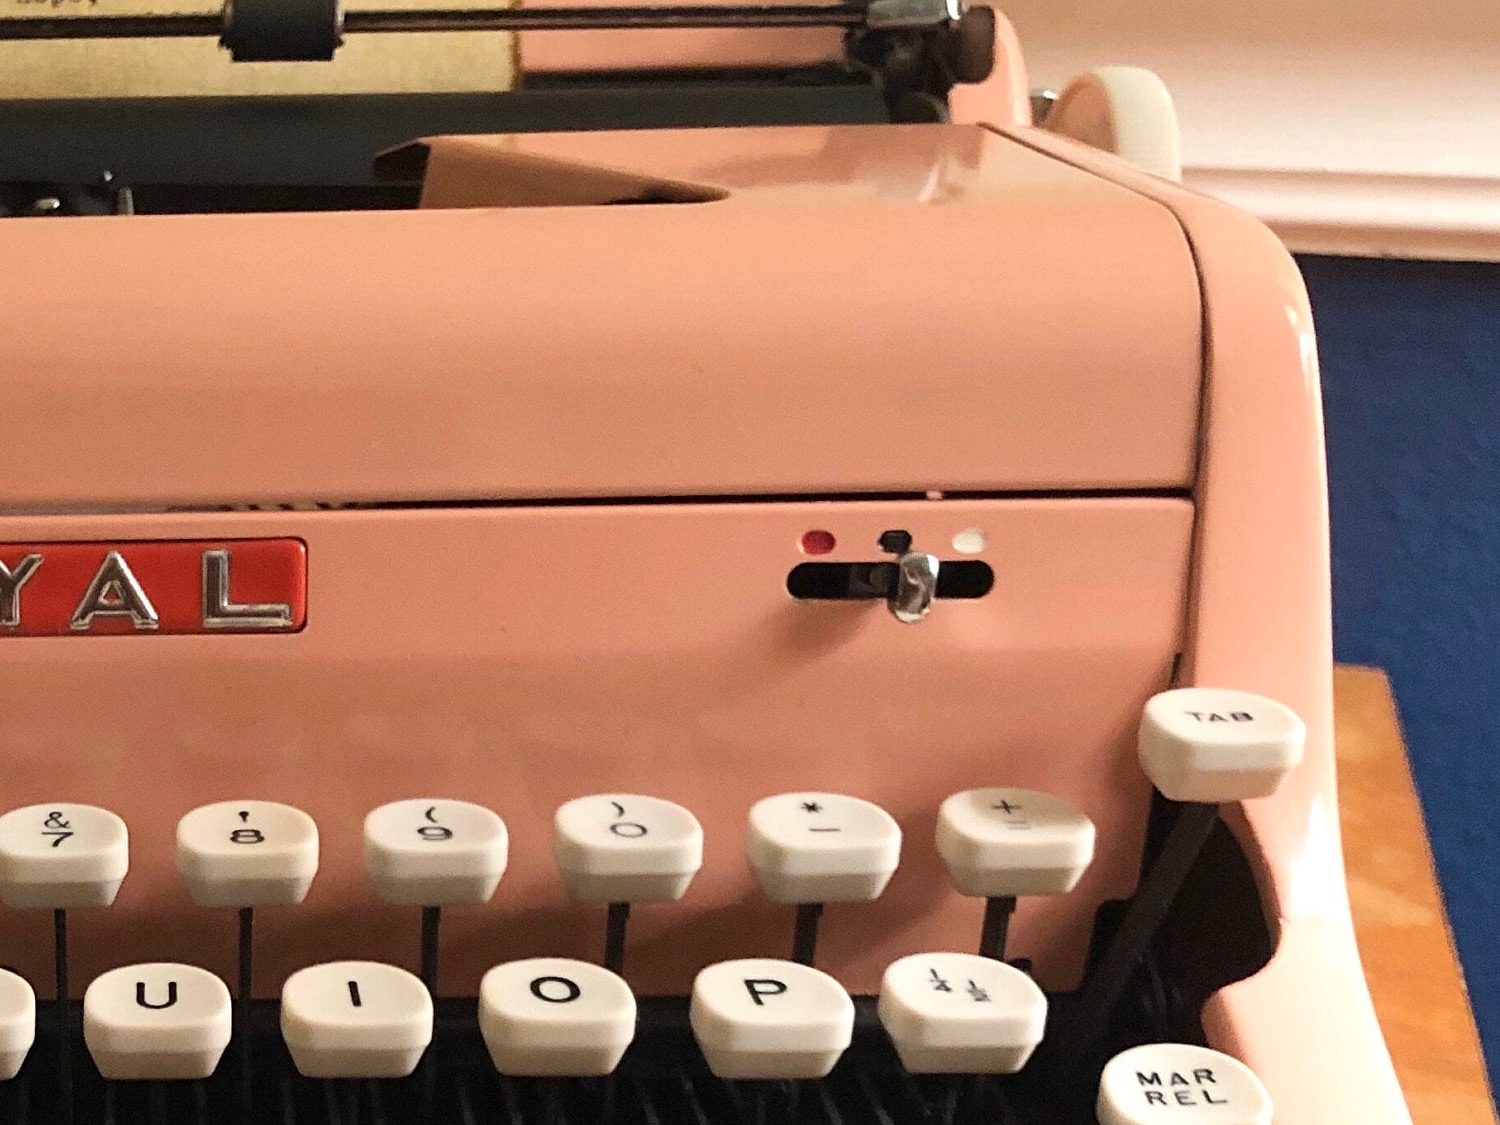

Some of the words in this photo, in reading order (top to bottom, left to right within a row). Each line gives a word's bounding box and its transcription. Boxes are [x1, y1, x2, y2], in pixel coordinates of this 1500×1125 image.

[1184, 711, 1254, 723] TAB
[424, 806, 438, 824] (
[611, 801, 626, 818] )
[992, 799, 1022, 815] +
[43, 811, 70, 829] &
[41, 831, 74, 848] 7
[229, 828, 266, 845] 8
[416, 826, 453, 841] 9
[135, 981, 178, 1010] U
[347, 980, 362, 1008] I
[529, 975, 582, 1004] O
[743, 978, 788, 1006] P
[1135, 1068, 1218, 1087] MAR
[1144, 1089, 1228, 1106] REL
